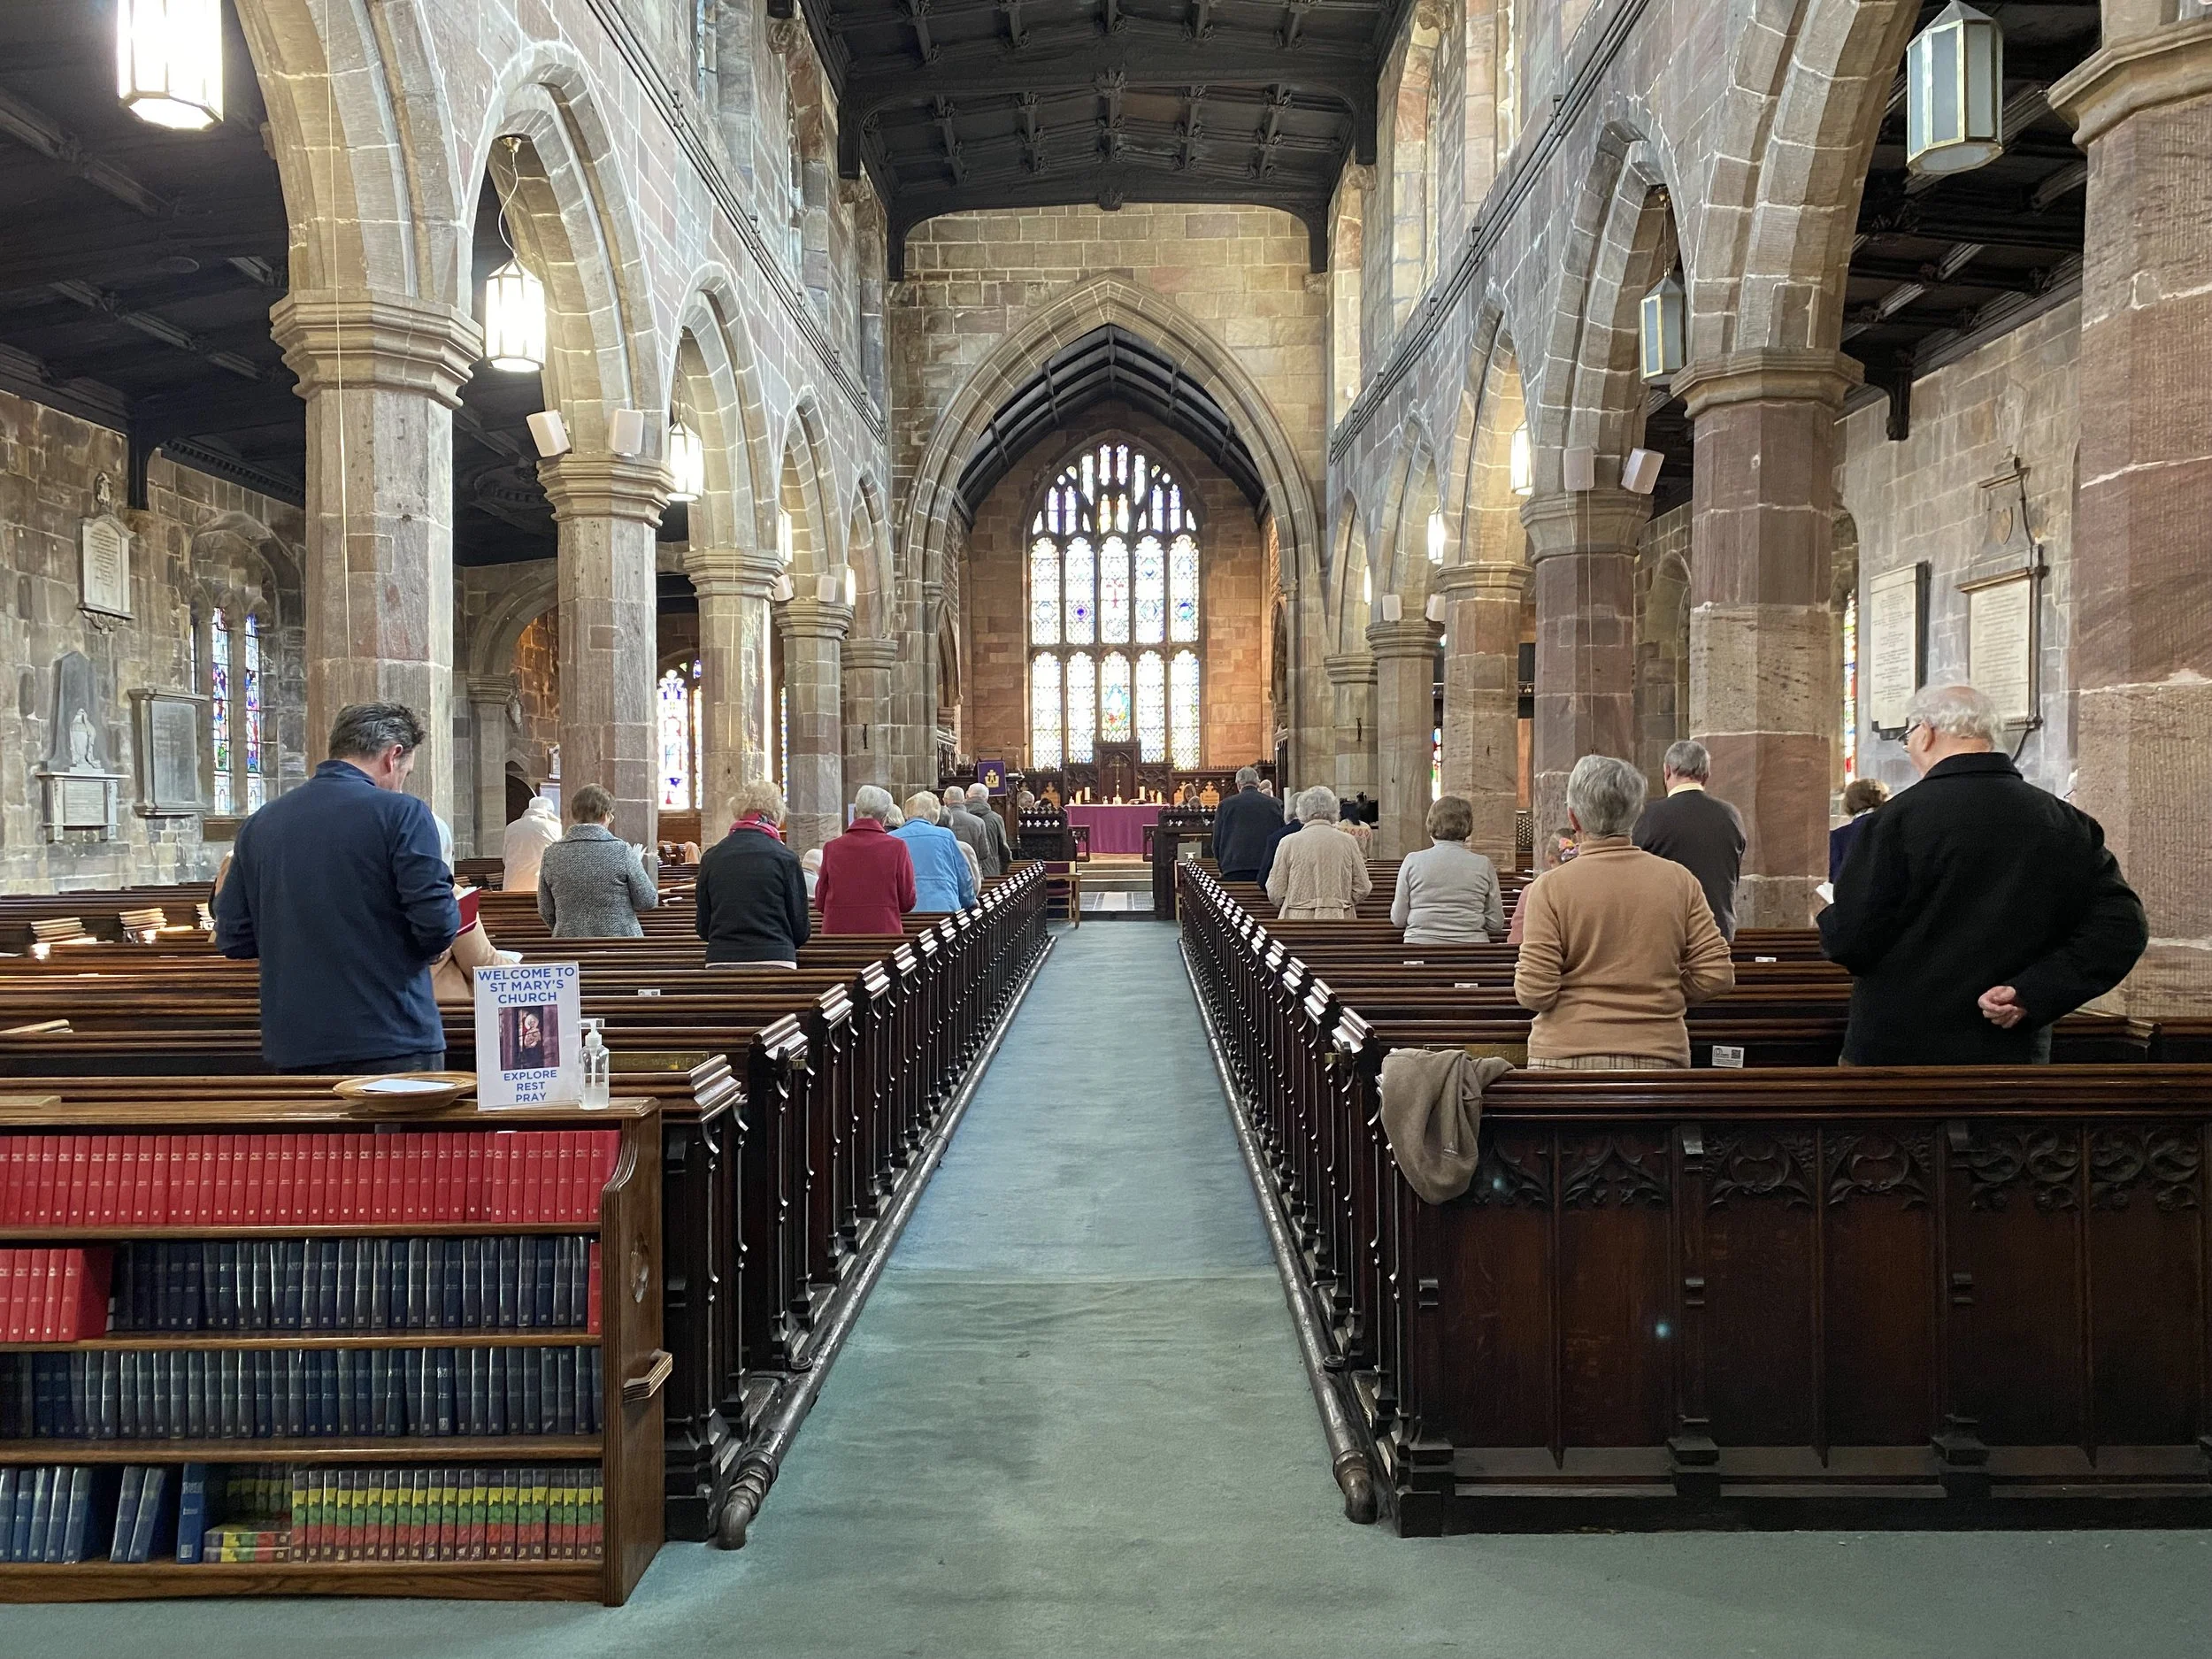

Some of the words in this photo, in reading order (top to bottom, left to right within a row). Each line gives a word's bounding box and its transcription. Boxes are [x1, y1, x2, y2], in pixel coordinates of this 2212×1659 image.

[478, 968, 551, 980] WELCOME
[556, 967, 575, 977] TO
[490, 982, 507, 992] ST
[511, 979, 565, 991] MARY'S
[498, 992, 557, 1004] CHURCH
[503, 1069, 557, 1081] EXPLORE
[516, 1081, 546, 1092] REST
[515, 1092, 547, 1103] PRAY
